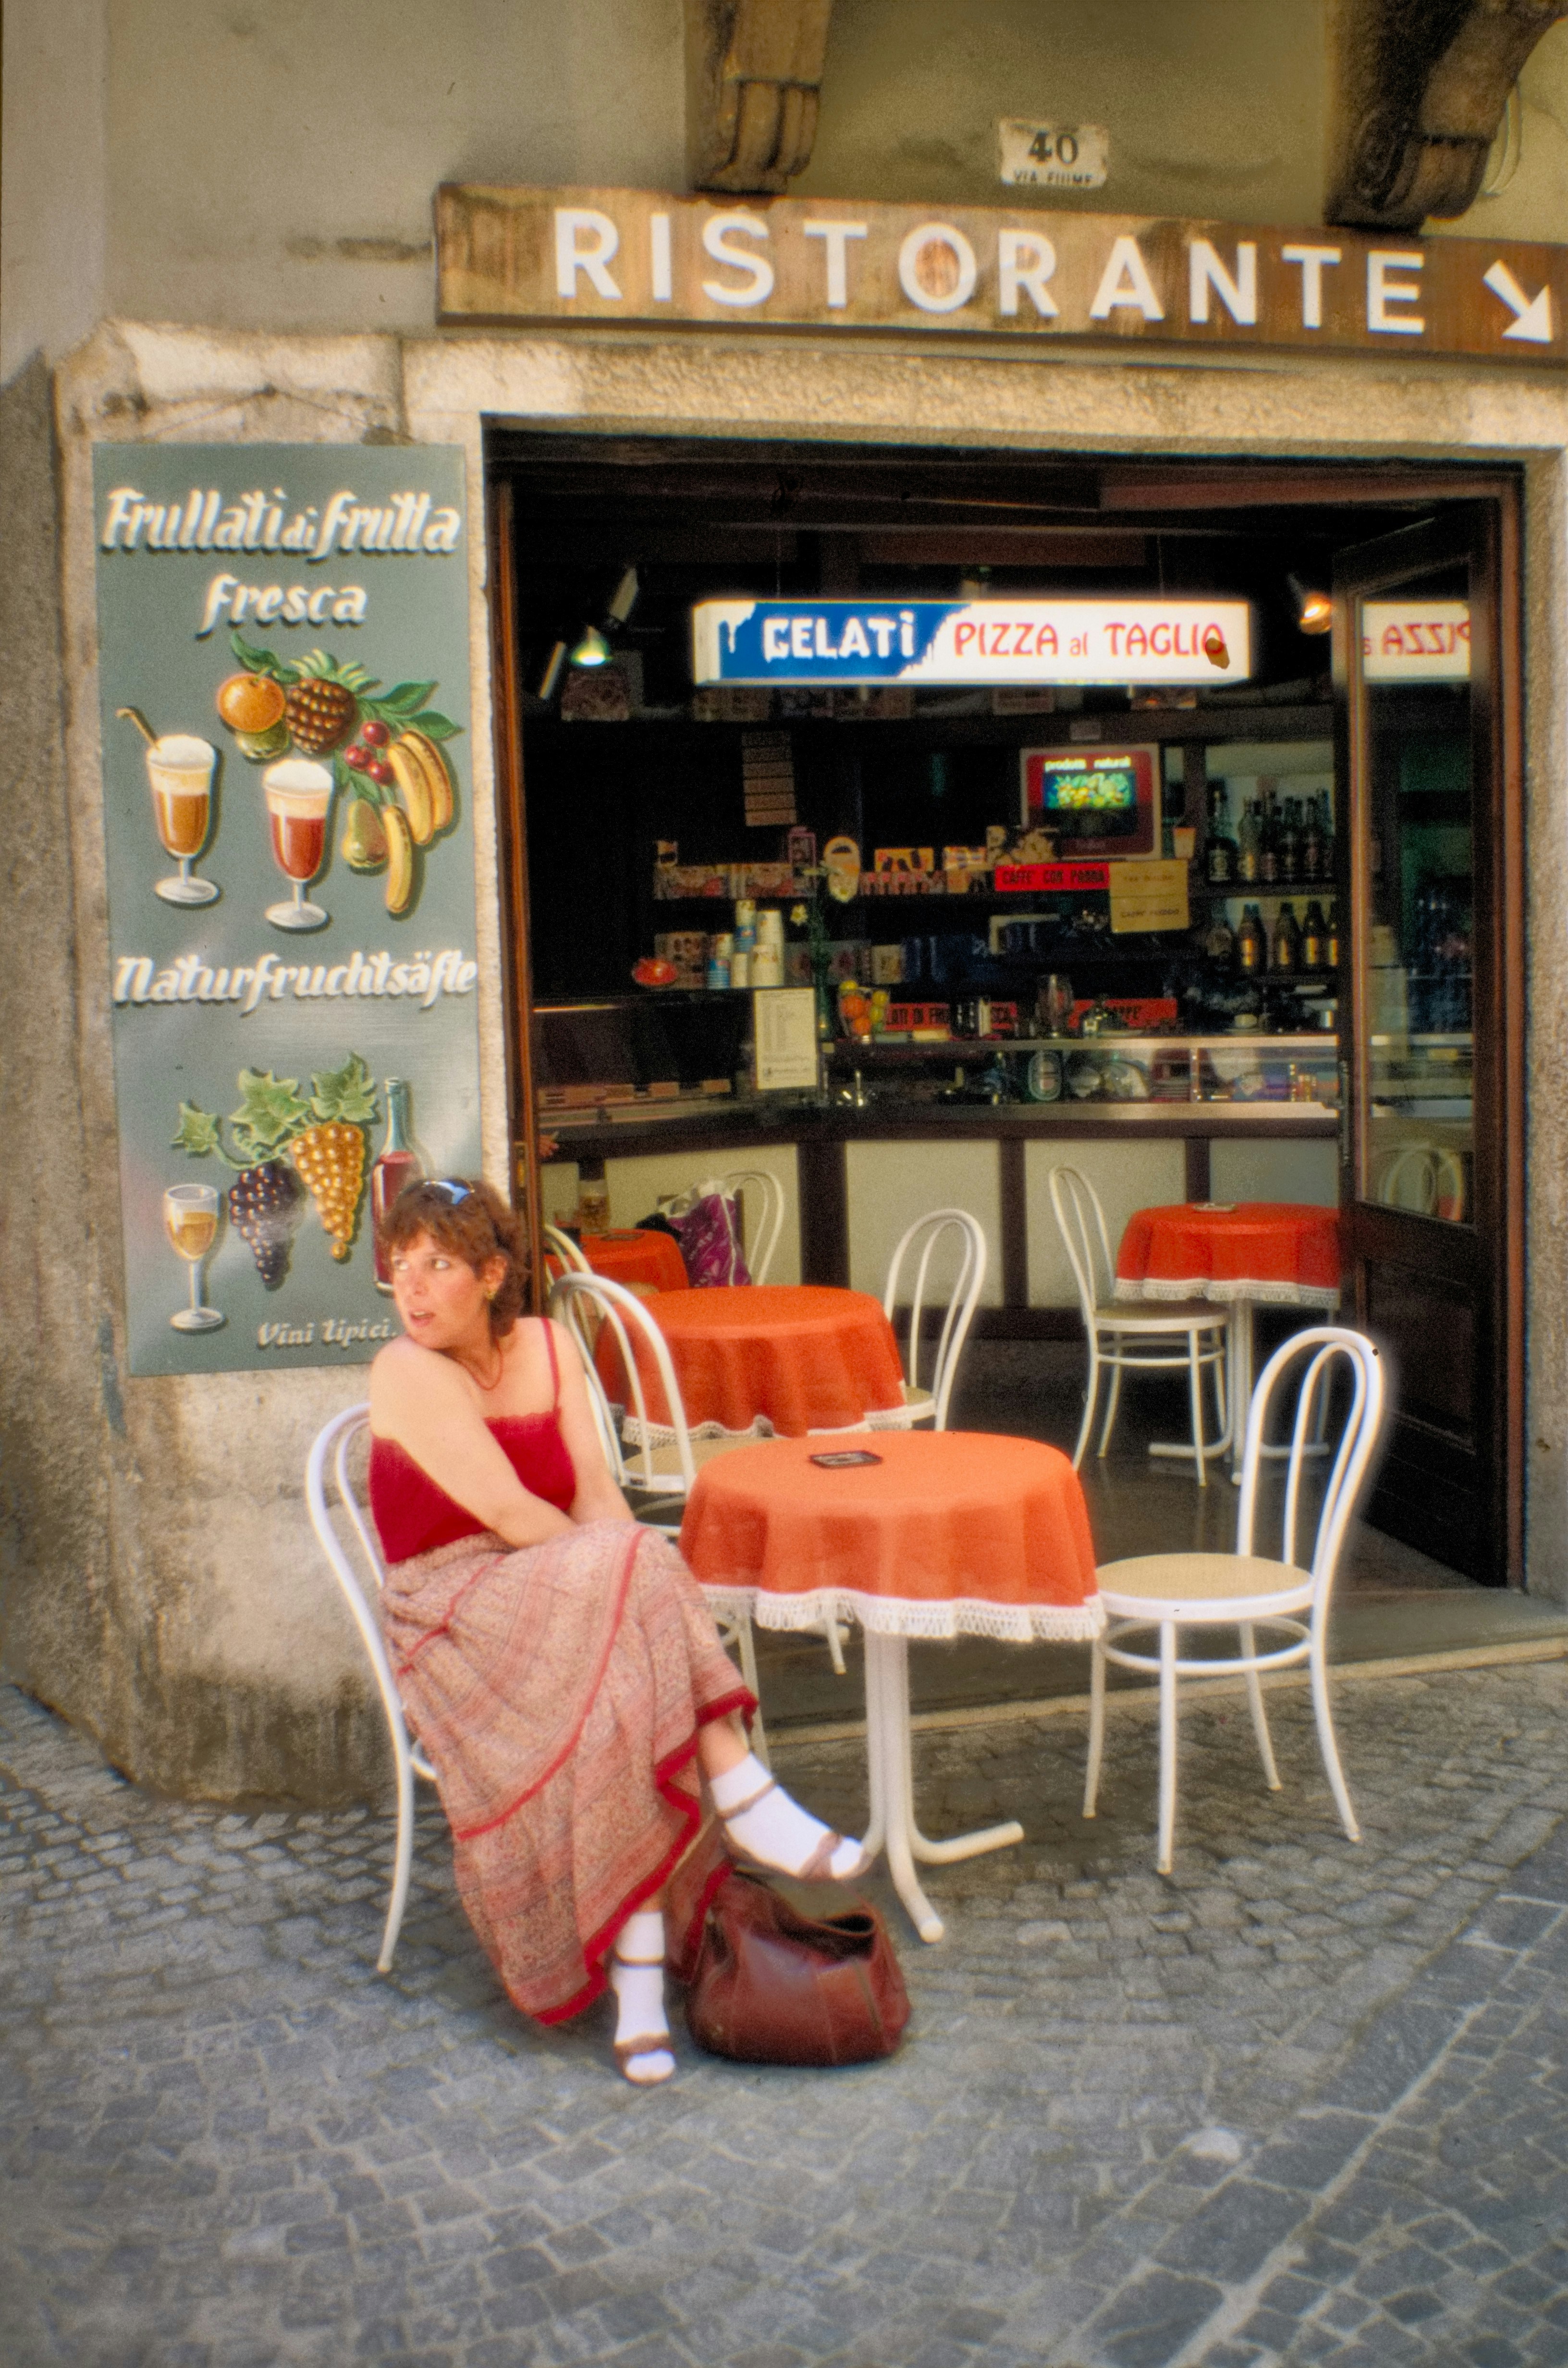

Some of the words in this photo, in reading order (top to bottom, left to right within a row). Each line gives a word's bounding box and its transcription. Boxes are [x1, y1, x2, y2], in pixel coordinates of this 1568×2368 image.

[1028, 131, 1078, 164] 40
[1014, 170, 1037, 184] VIA
[554, 208, 1425, 335] RISTORANTE
[102, 487, 287, 551] Frullati
[283, 506, 318, 552] di
[306, 491, 461, 561] frutta
[954, 622, 1058, 656] PIZZA
[1069, 632, 1088, 656] al
[1103, 622, 1225, 656] TAGLIO
[112, 950, 478, 1017] Naturfruchtsäfte
[257, 1321, 315, 1347] Vini
